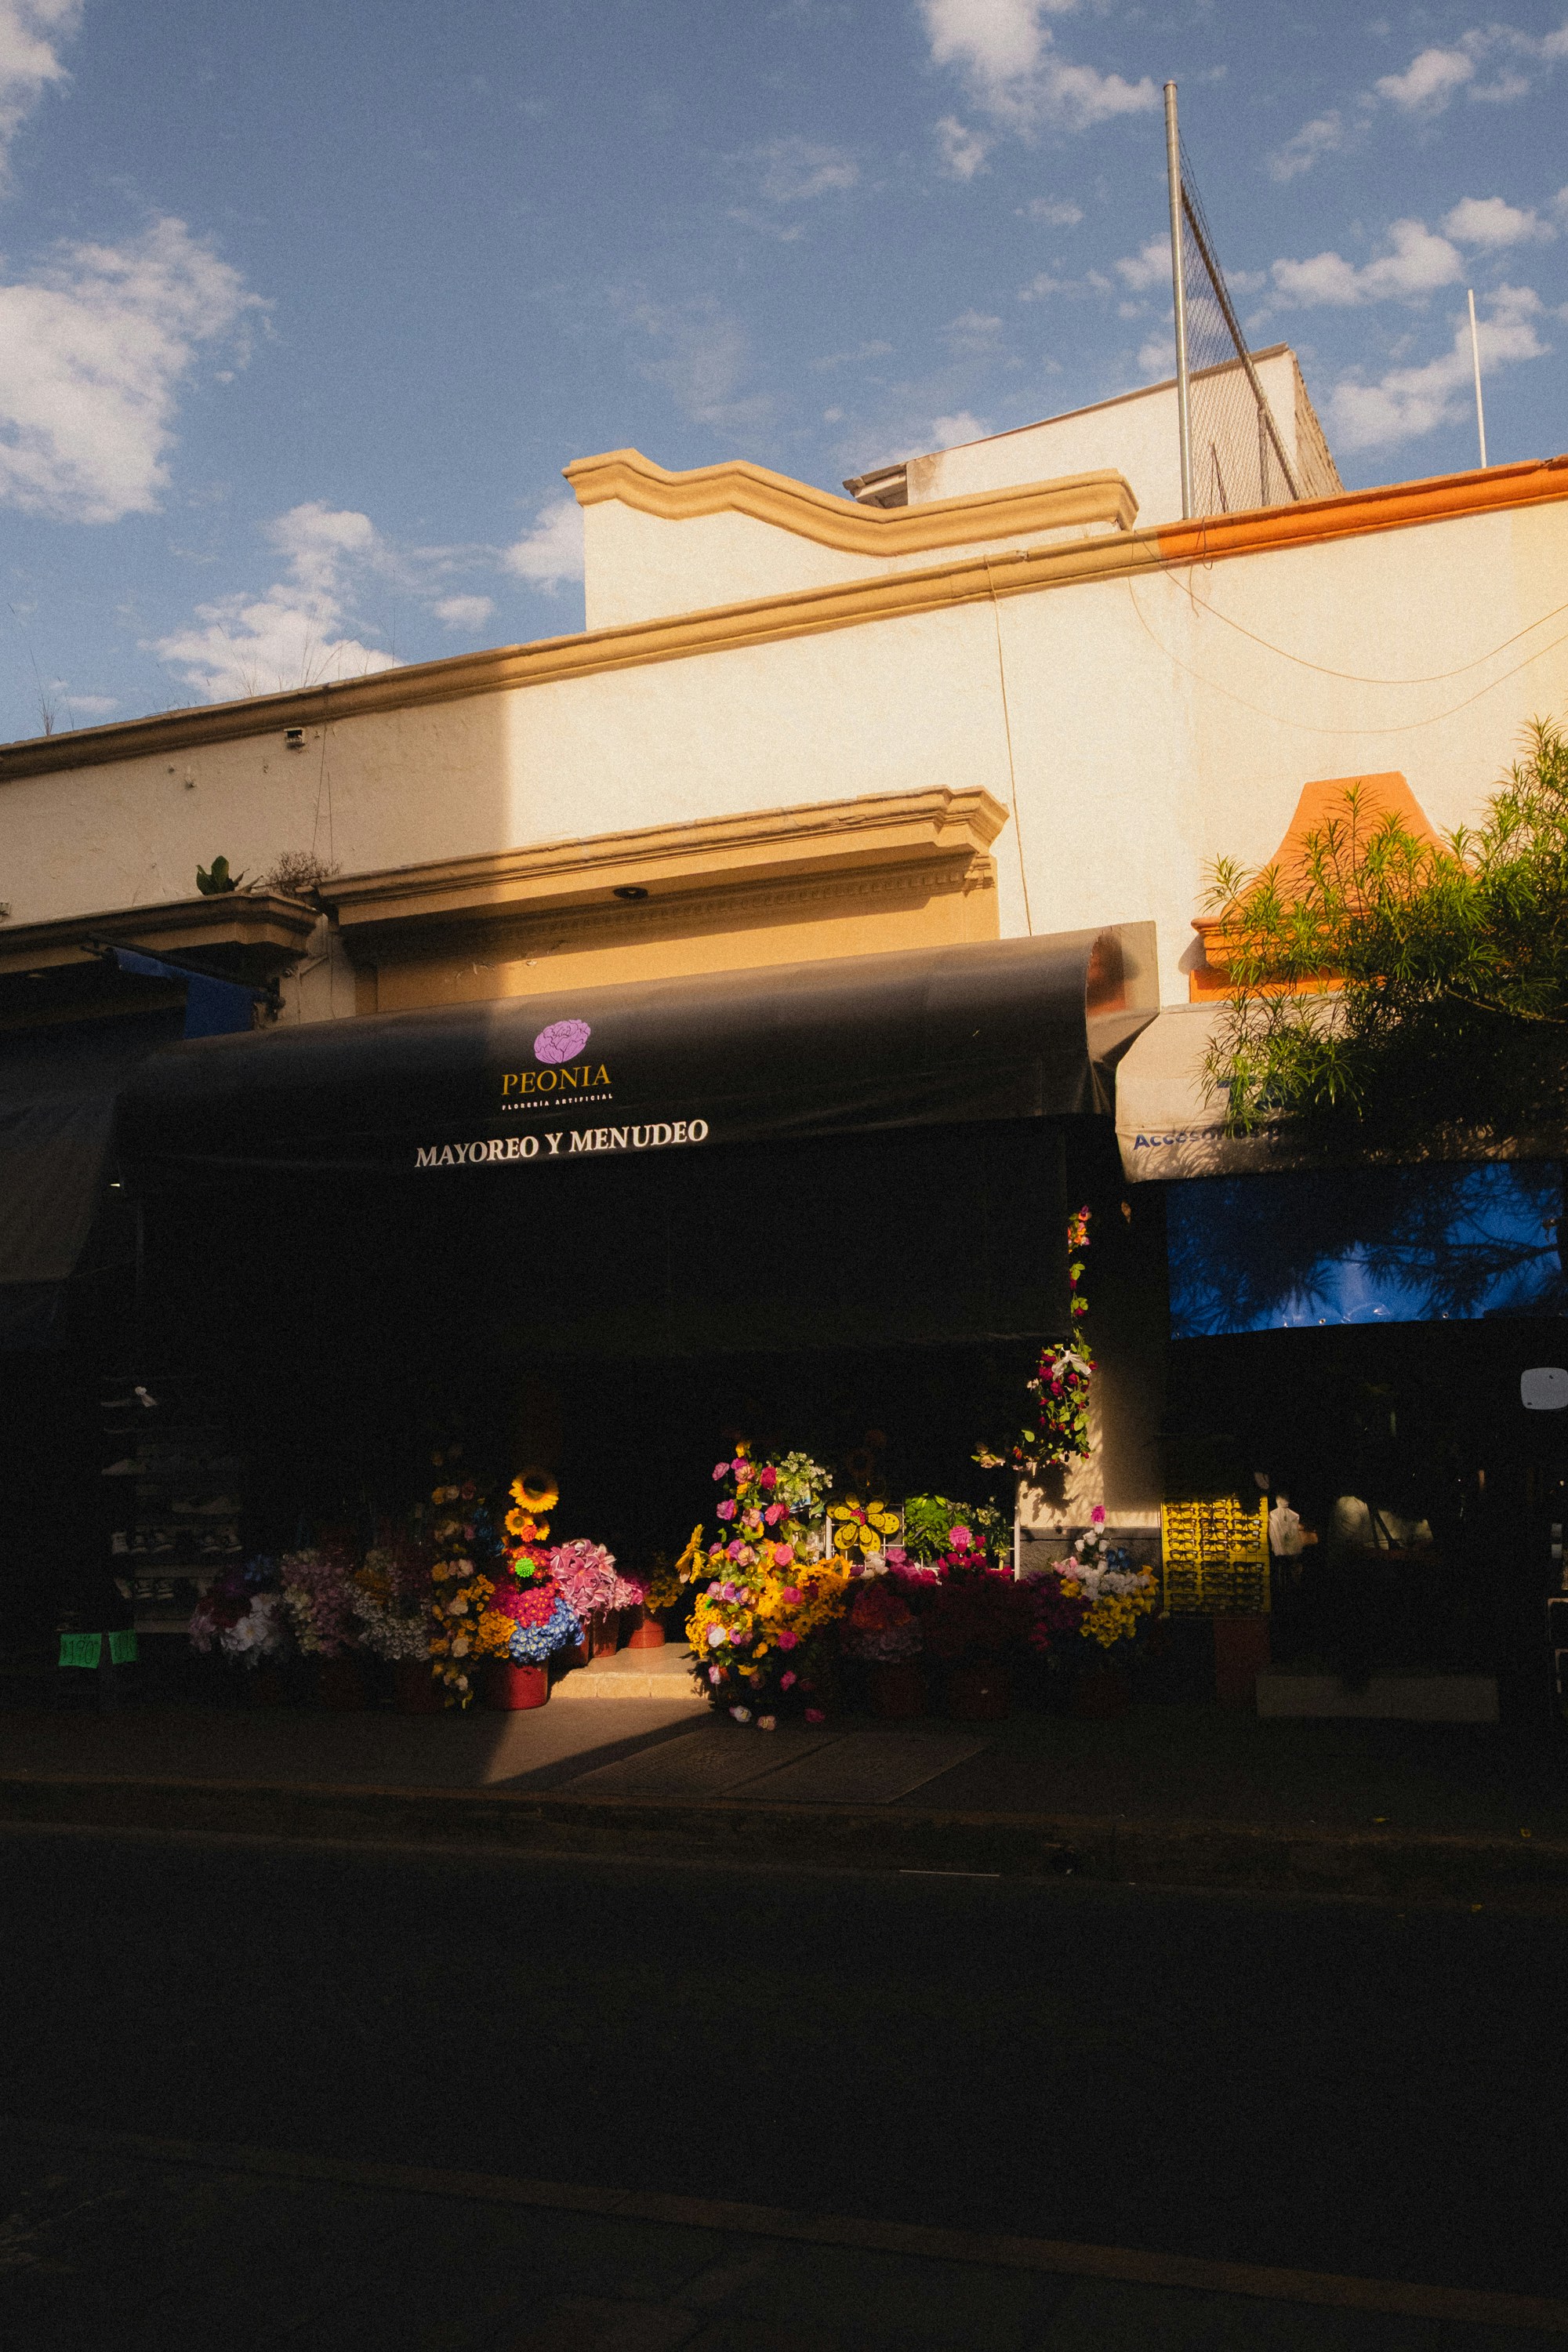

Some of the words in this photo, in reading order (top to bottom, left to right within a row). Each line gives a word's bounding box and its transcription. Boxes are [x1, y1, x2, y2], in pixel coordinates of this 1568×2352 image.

[501, 1063, 612, 1096] PEONIA
[555, 1093, 612, 1105] ARTIFICIAL
[414, 1135, 539, 1167] MAYOREO
[544, 1132, 564, 1155] Y
[568, 1119, 709, 1152] MENUDEO
